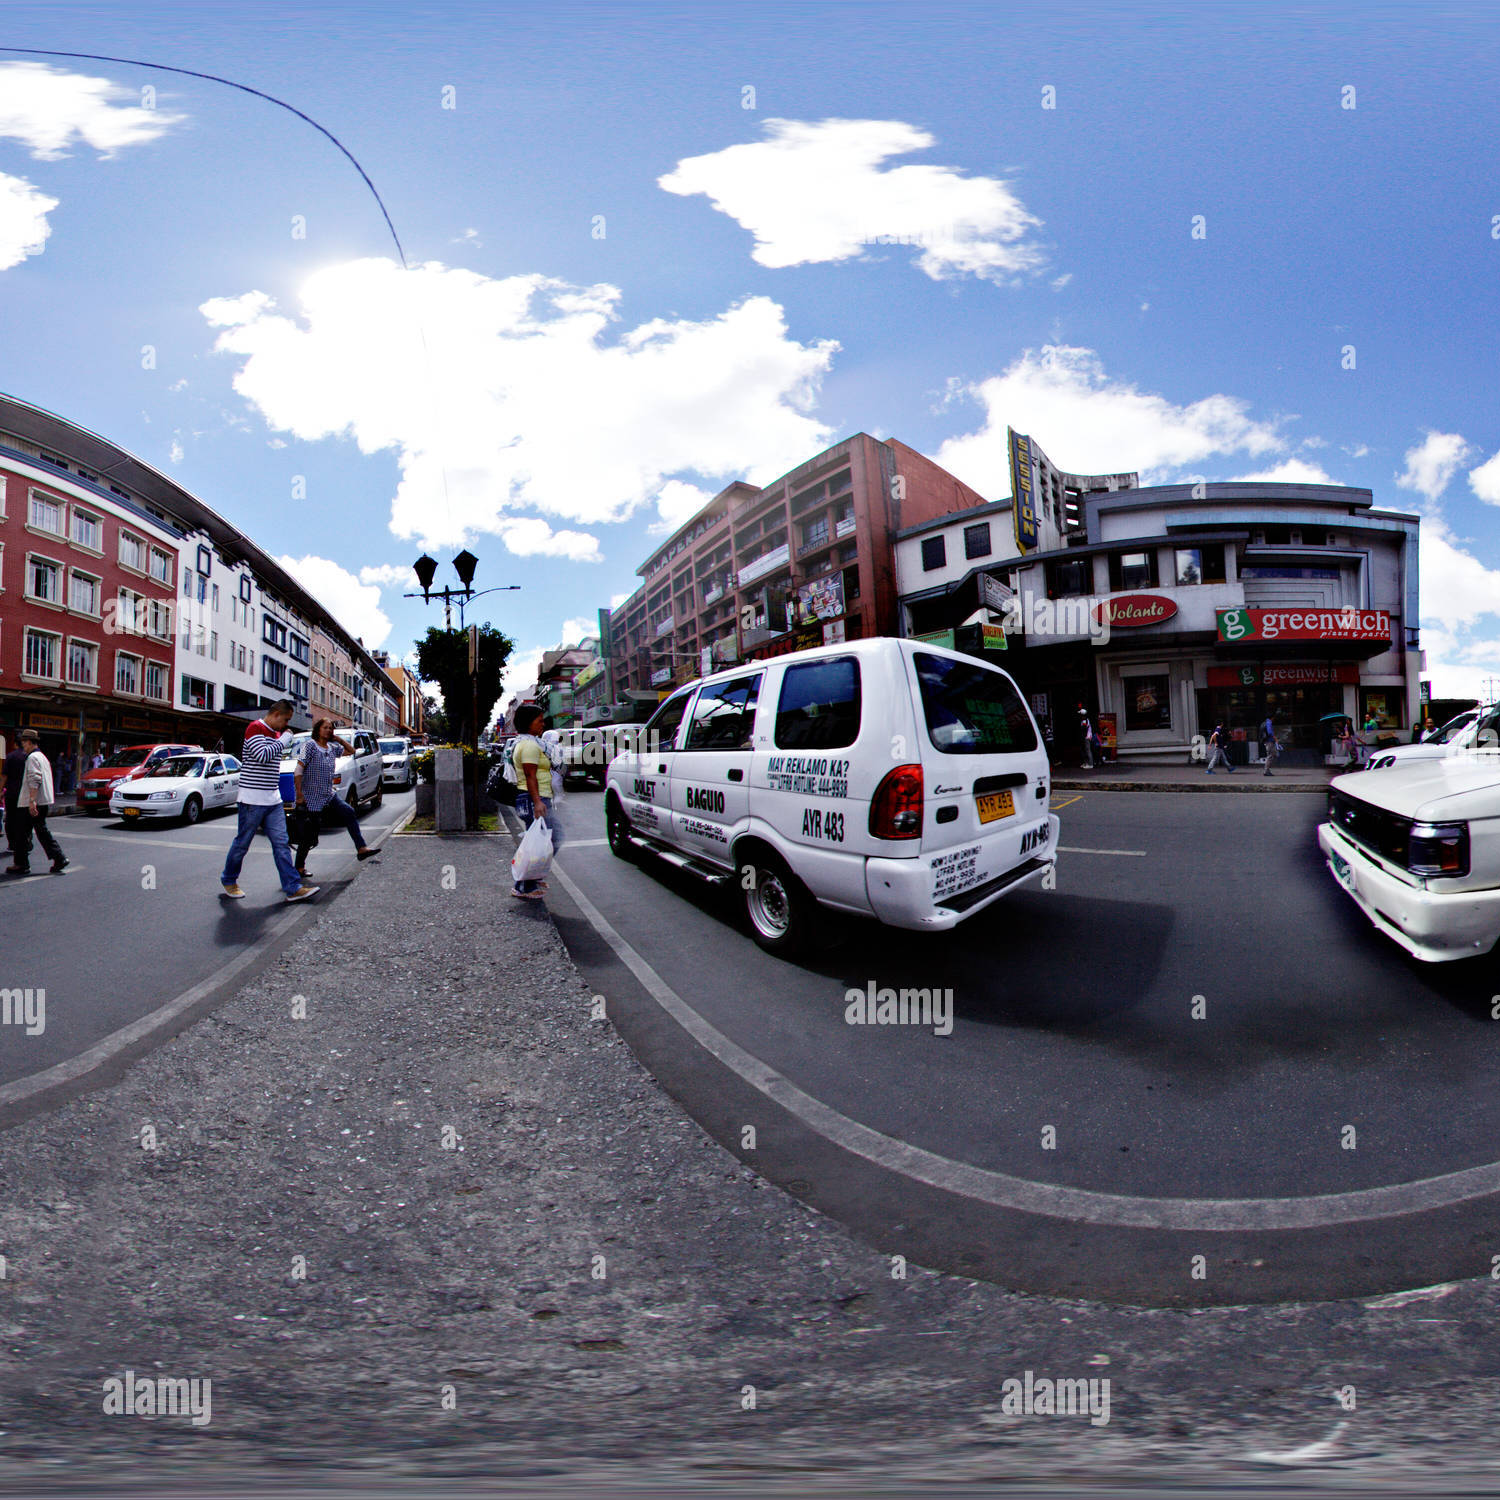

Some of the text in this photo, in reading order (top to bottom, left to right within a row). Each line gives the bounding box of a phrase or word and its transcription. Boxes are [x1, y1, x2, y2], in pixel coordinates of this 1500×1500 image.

[1017, 438, 1034, 537] SESSION
[1105, 601, 1165, 622] Volante
[1262, 610, 1390, 639] greenwich
[768, 757, 849, 778] MAY REKLAMO KA?
[634, 779, 656, 798] DOLET
[687, 787, 725, 814] BAGUIO
[802, 808, 845, 843] AYR 483
